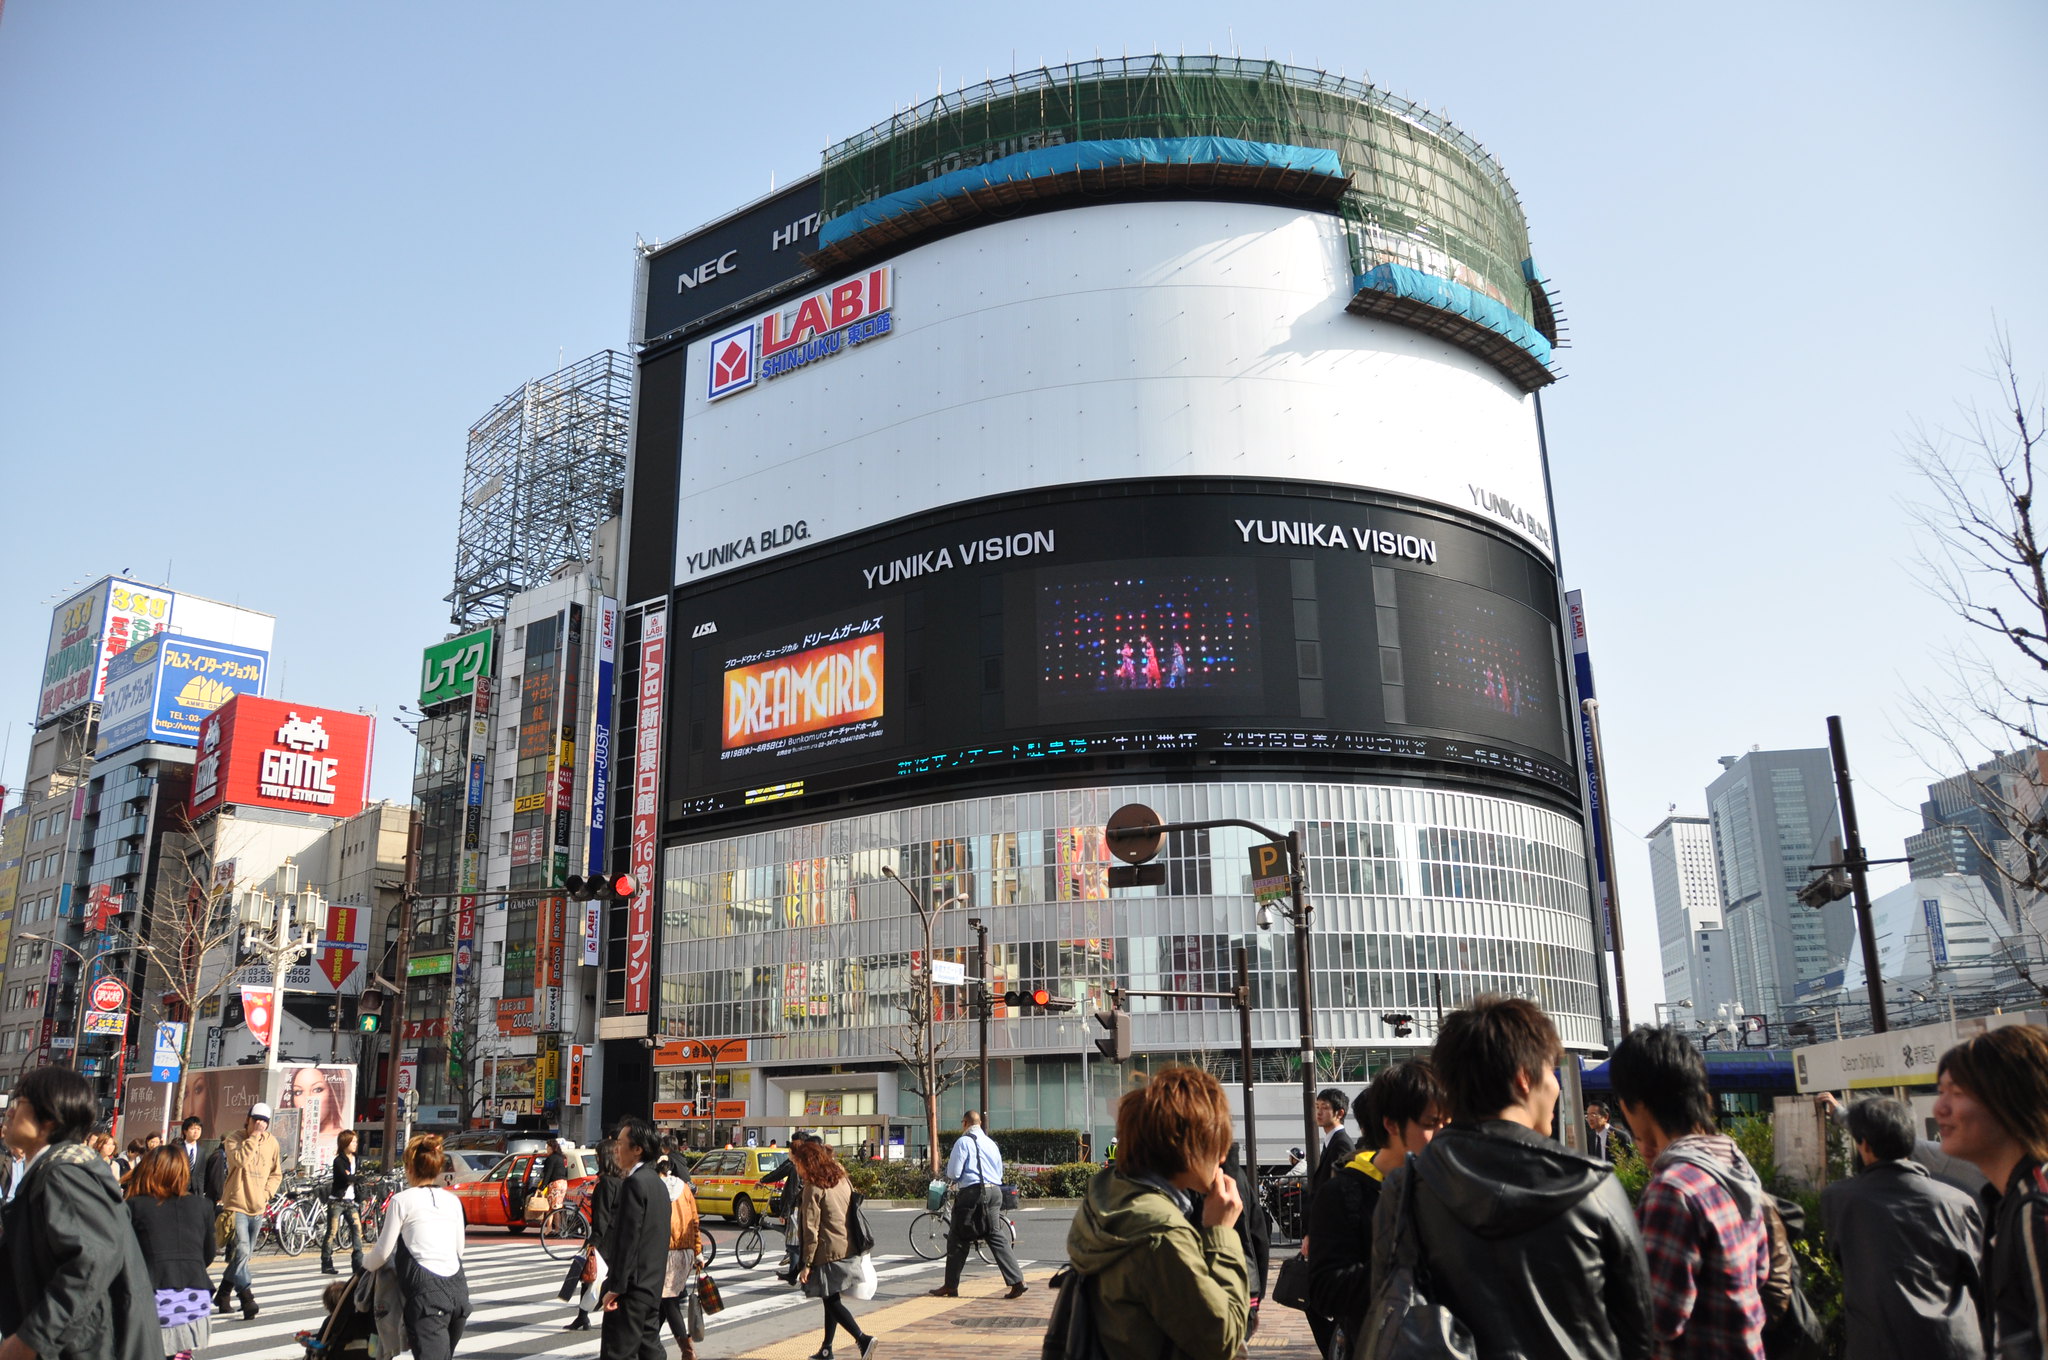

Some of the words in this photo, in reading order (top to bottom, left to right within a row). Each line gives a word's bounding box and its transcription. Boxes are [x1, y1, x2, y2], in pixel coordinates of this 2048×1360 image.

[677, 249, 738, 295] NEC
[761, 266, 891, 358] LABI
[761, 331, 842, 379] SHINJUKU
[846, 311, 892, 346] 東口館
[1468, 484, 1527, 525] YUNIKA
[686, 536, 757, 575] YUNIKA
[760, 520, 812, 555] BLDG.
[1234, 519, 1349, 549] YUNIKA
[1352, 527, 1438, 563] VISION
[863, 546, 954, 590] YUNIKA
[958, 529, 1056, 565] VISION
[112, 586, 168, 619] 389
[603, 609, 611, 636] LABI
[646, 625, 663, 637] LABI
[803, 615, 884, 649] ドリームガールズ
[1575, 614, 1584, 639] LABI
[165, 650, 260, 682] アムス・インターナショナル
[424, 642, 487, 695] レイク
[728, 645, 878, 740] DREAMGIRLS
[788, 731, 828, 747] Bunkamura
[261, 749, 339, 792] GAME
[592, 808, 604, 830] For
[1259, 846, 1278, 876] P
[587, 910, 595, 939] LABI
[159, 1026, 176, 1048] P
